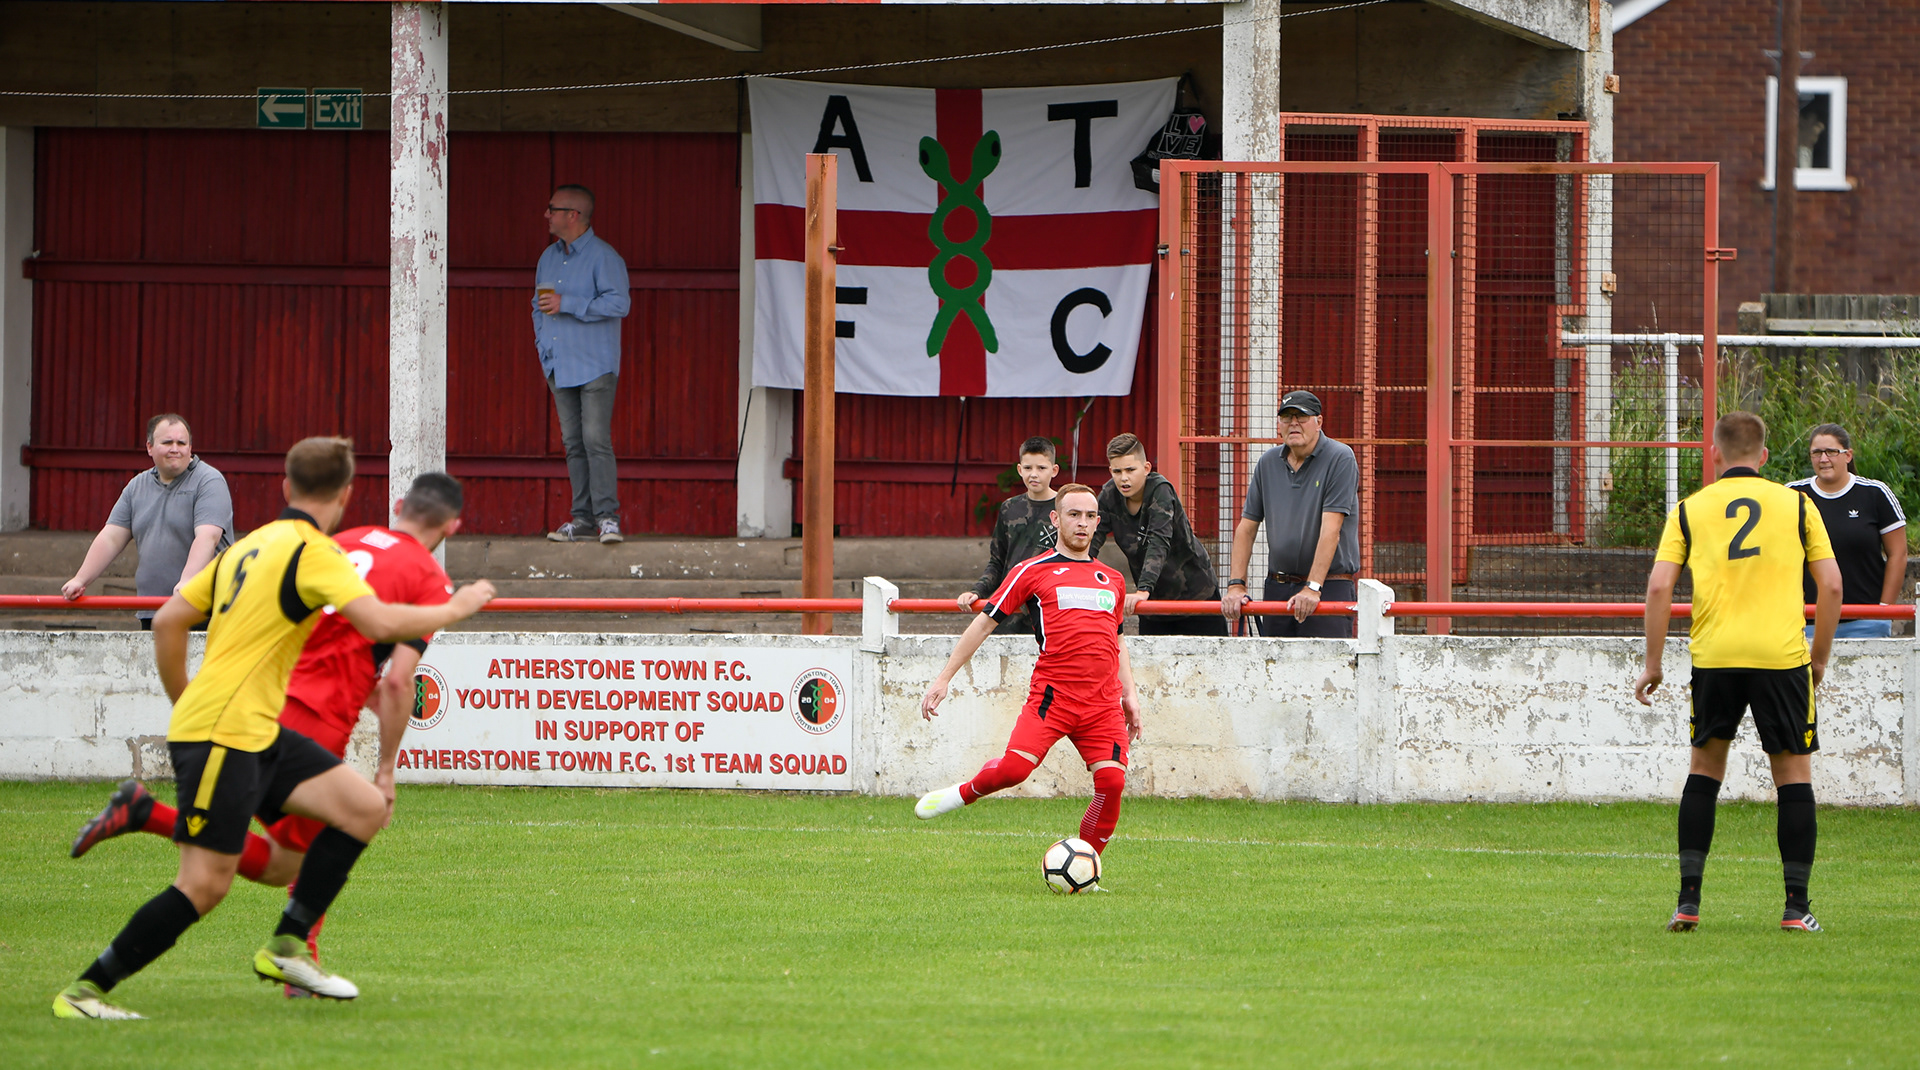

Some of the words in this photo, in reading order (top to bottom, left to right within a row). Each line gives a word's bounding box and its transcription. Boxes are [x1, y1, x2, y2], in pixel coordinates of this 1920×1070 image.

[315, 95, 360, 122] Exit
[805, 95, 875, 182] A
[1047, 100, 1118, 188] T
[1050, 287, 1113, 374] C
[1725, 497, 1762, 561] 2
[487, 658, 635, 680] ATHERSTONE
[641, 660, 707, 680] TOWN
[714, 660, 751, 681] F.C.
[793, 671, 828, 695] ATHERSTONE
[829, 676, 842, 696] TOWN
[455, 688, 530, 709] YOUTH
[537, 690, 700, 711] DEVELOPMENT
[706, 691, 785, 713] SQUAD
[535, 720, 557, 740] IN
[564, 720, 669, 742] SUPPORT
[675, 721, 705, 742] OF
[794, 711, 824, 733] FOOTBALL
[397, 749, 540, 770] ATHERSTONE
[546, 750, 612, 771] TOWN
[620, 752, 656, 772] F.C.
[664, 753, 695, 773] 1st
[701, 753, 762, 774] TEAM
[769, 754, 847, 775] SQUAD
